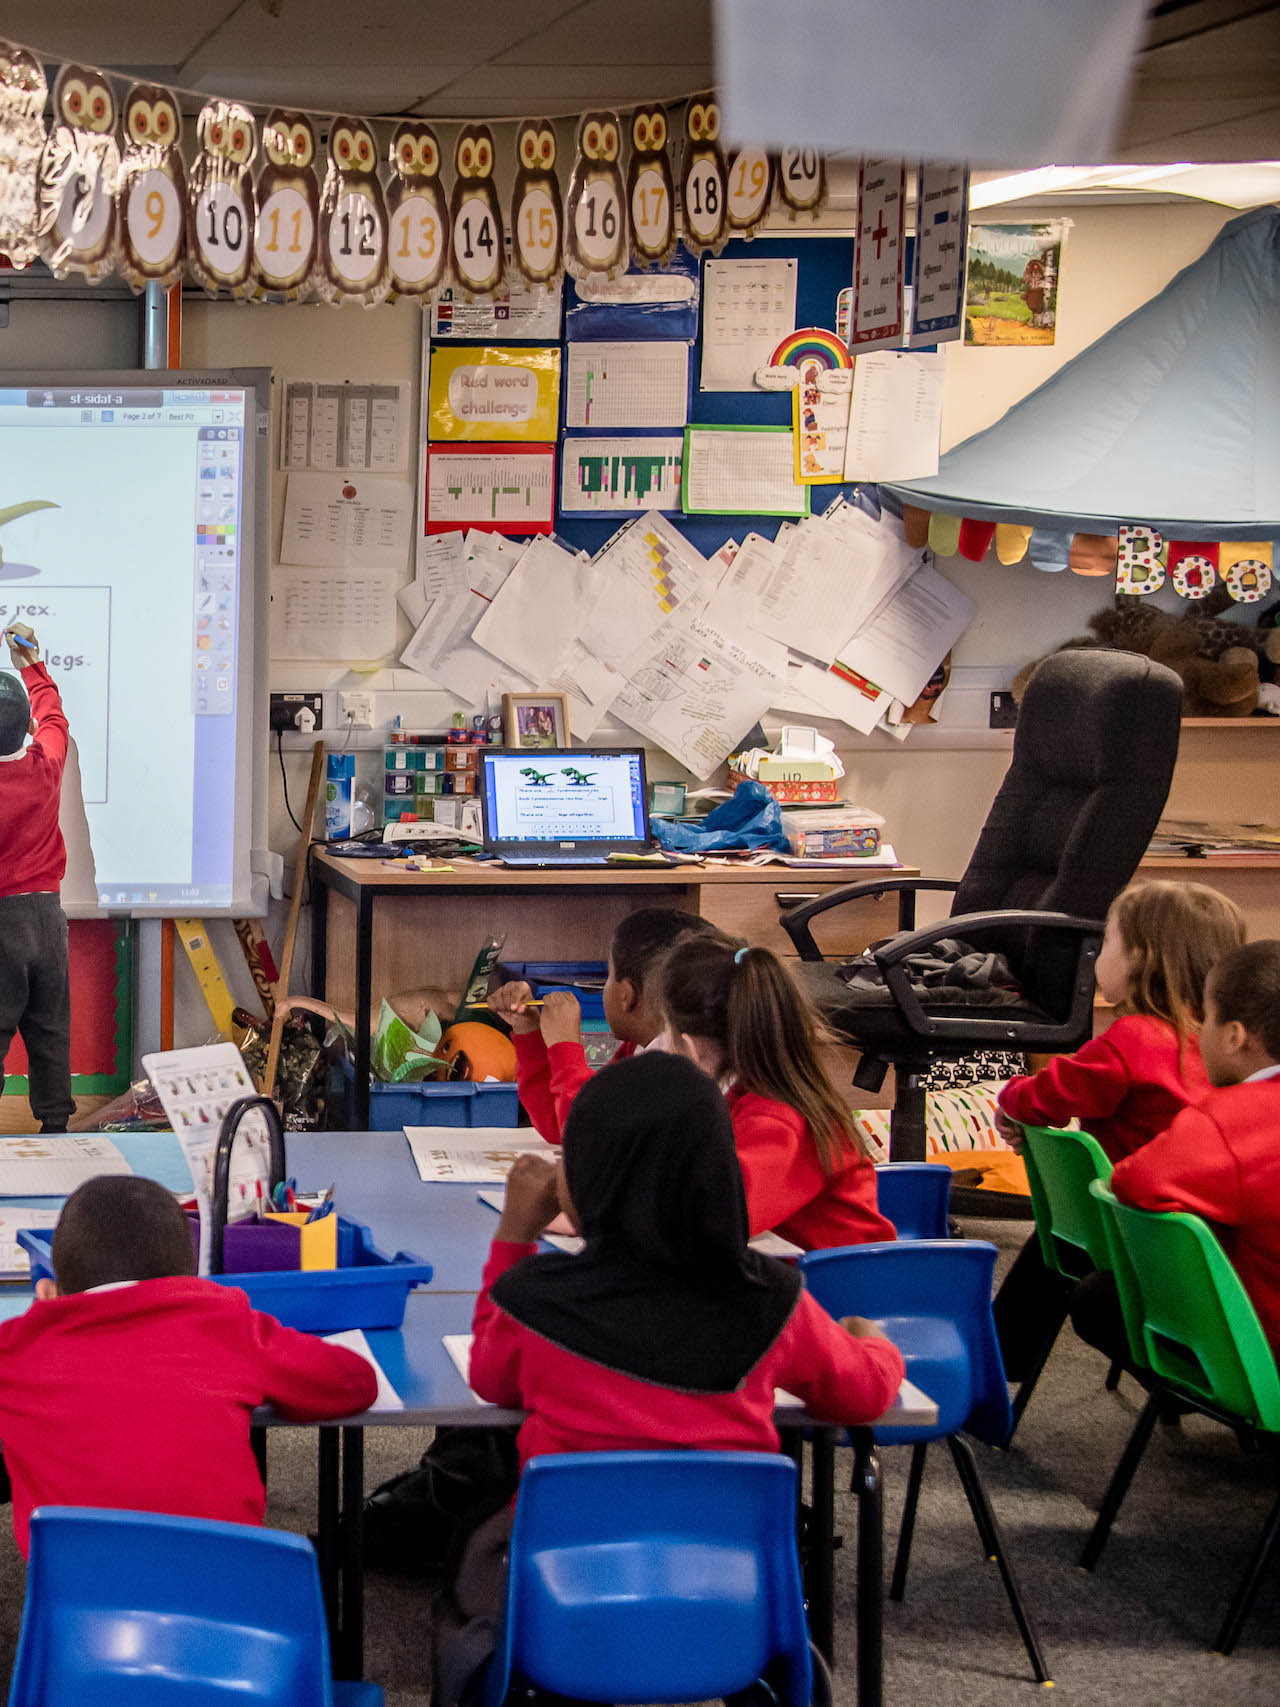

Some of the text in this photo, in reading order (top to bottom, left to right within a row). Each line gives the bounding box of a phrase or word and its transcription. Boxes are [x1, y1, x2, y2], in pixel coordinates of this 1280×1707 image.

[733, 159, 765, 199] 19
[787, 145, 817, 181] 20
[145, 191, 165, 238] 9
[639, 187, 665, 226] 17
[692, 176, 718, 214] 18
[205, 200, 242, 250] 10
[265, 208, 302, 252] 11
[339, 210, 376, 256] 12
[397, 215, 435, 258] 13
[462, 216, 493, 258] 14
[525, 208, 553, 249] 15
[585, 196, 616, 239] 16
[494, 374, 530, 388] word
[123, 412, 139, 421] Page
[168, 412, 184, 421] Best
[461, 400, 528, 418] challenge
[15, 603, 57, 618] rex.
[44, 649, 92, 671] legs.
